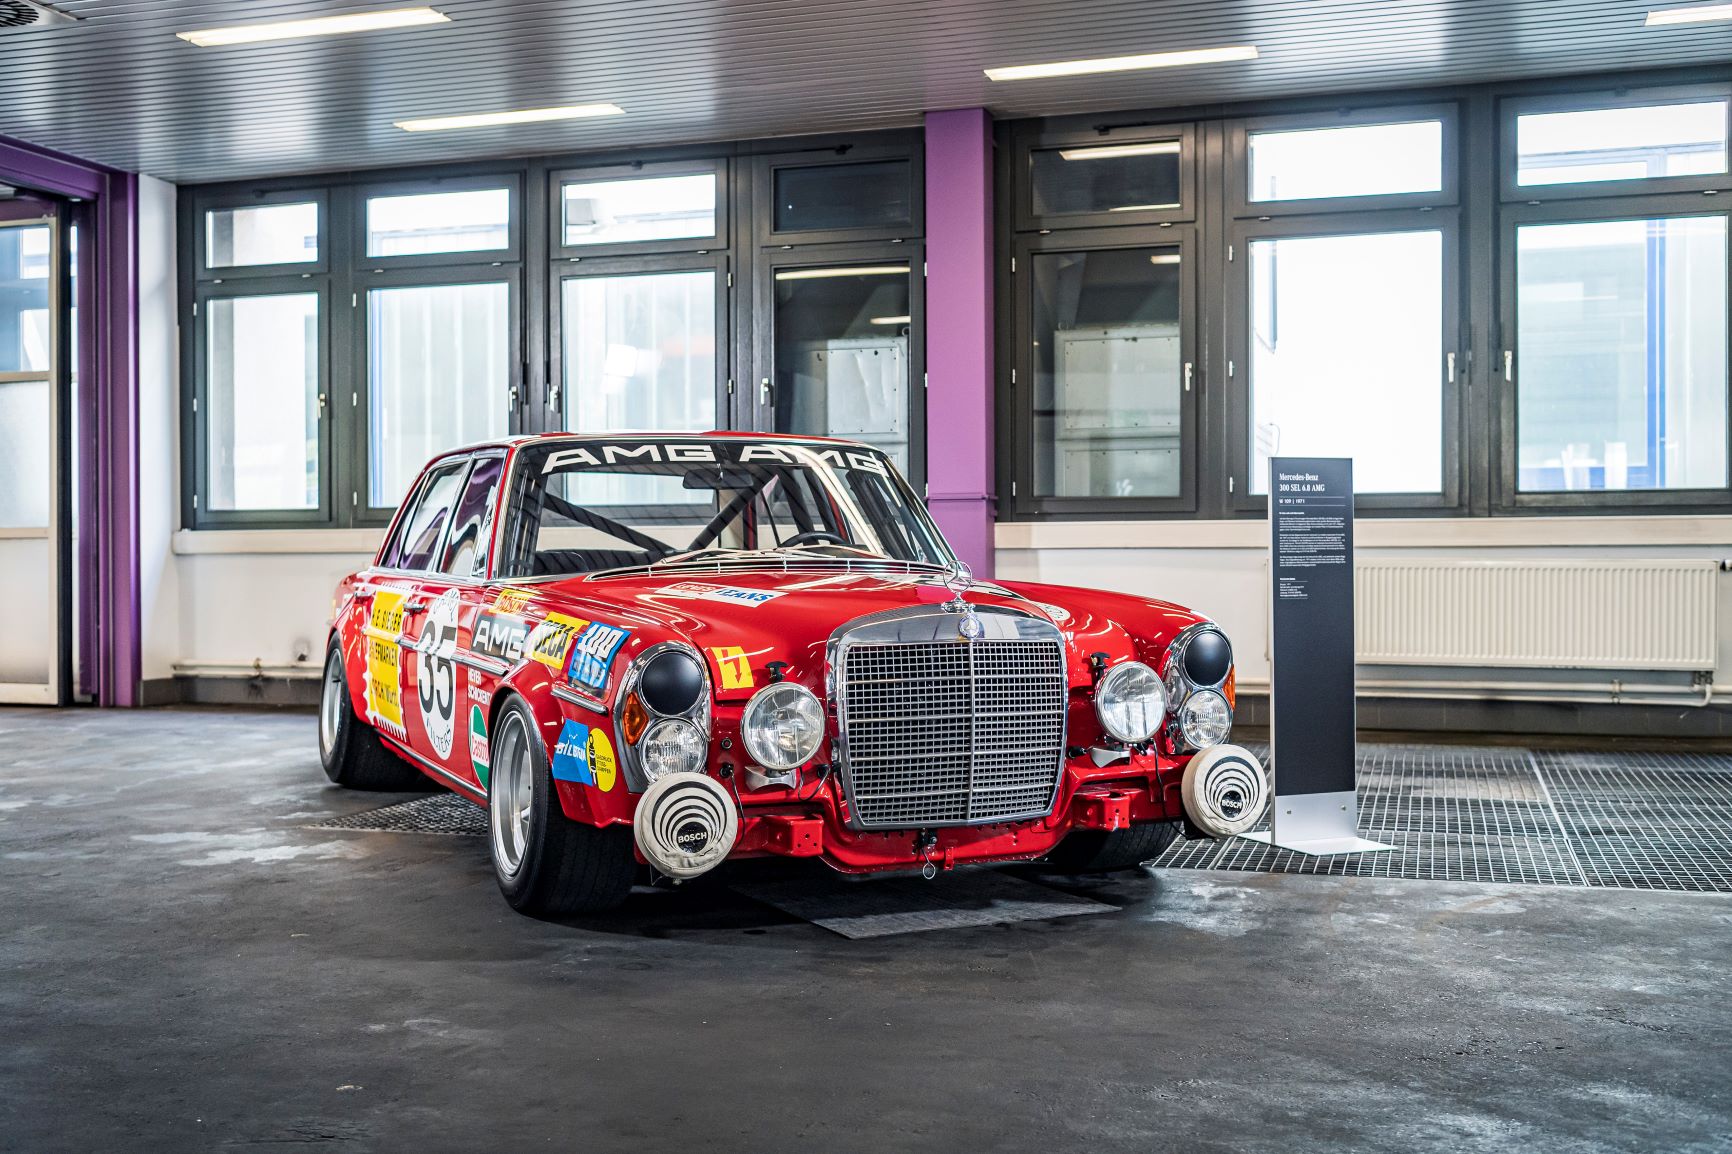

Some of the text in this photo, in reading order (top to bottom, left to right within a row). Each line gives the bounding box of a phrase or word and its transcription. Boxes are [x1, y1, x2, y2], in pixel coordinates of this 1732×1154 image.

[541, 444, 888, 477] AMG AMG
[1279, 473, 1319, 481] Mercedes-Benz
[1279, 484, 1325, 492] 300 SEL 6.8 AMG
[498, 595, 528, 613] BOSCH
[473, 620, 527, 660] AMG
[577, 623, 624, 658] 100
[418, 620, 457, 721] 35
[472, 736, 489, 762] Castro
[1221, 799, 1242, 808] BOSCH
[677, 832, 708, 844] BOSCH
